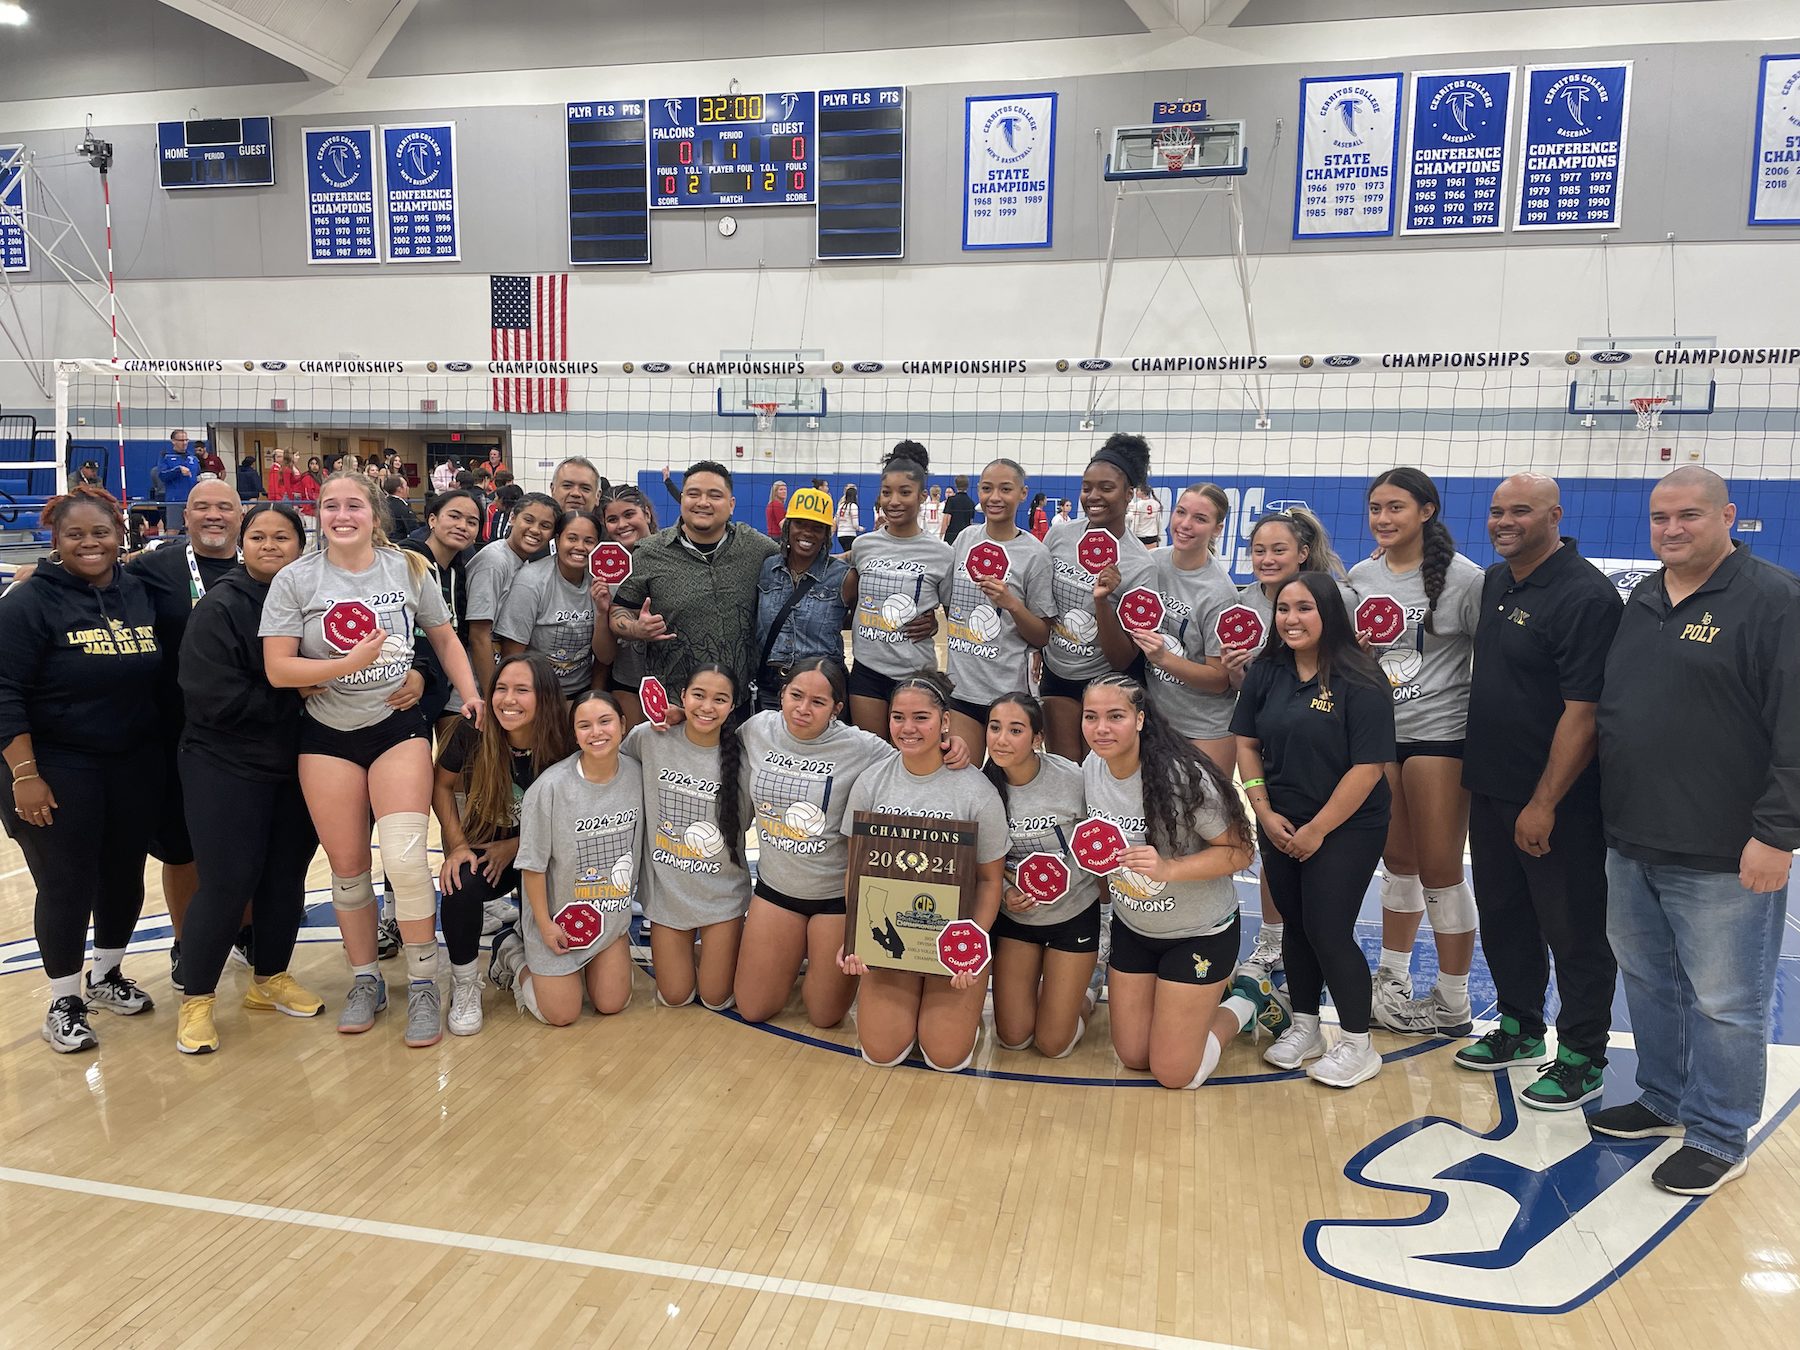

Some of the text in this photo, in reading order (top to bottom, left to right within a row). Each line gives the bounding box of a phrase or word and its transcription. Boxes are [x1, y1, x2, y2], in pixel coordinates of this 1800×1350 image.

[1430, 80, 1493, 111] CERRITOS COLLEGE
[1545, 74, 1609, 104] CERRITOS COLLEGE
[823, 91, 899, 106] PLYR FLS PTS
[1320, 87, 1380, 117] CERRITOS COLLEGE
[569, 104, 640, 118] PLYR FLS PTS
[703, 96, 761, 122] 32:00
[983, 106, 1037, 133] CERRITOS COLLEGE
[653, 127, 695, 139] FALCONS
[720, 131, 743, 139] PERIOD
[772, 122, 803, 135] GUEST
[1557, 127, 1591, 137] BASEBALL
[420, 133, 441, 156] COLLEGE
[1442, 133, 1476, 143] BASEBALL
[165, 144, 266, 159] HOME GUEST
[341, 136, 361, 159] COLLEGE
[680, 142, 692, 164] 0
[732, 143, 737, 158] 1
[792, 137, 804, 160] 0
[1415, 147, 1501, 160] CONFERENCE
[1530, 142, 1617, 155] CONFERENCE
[205, 152, 224, 160] PERIOD
[1324, 154, 1370, 166] STATE
[1528, 155, 1616, 170] CHAMPIONS
[657, 167, 678, 175] FOULS
[685, 166, 702, 175] T.O.L.
[709, 164, 754, 174] PLAYER FOUL
[760, 164, 778, 172] T.O.L.
[786, 162, 807, 171] FOULS
[1306, 166, 1388, 180] CHAMPIONS
[1415, 160, 1500, 175] CHAMPIONS
[1765, 167, 1789, 175] 2006
[795, 172, 804, 190] 0
[988, 169, 1029, 180] STATE
[1530, 172, 1612, 183] 1976 1977 1978
[665, 176, 675, 194] 0
[689, 176, 699, 193] 2
[746, 175, 751, 190] 1
[765, 173, 774, 190] 2
[972, 181, 1045, 194] CHAMPIONS
[1308, 182, 1384, 192] 1966 1970 1973
[1416, 177, 1496, 188] 1959 1962
[390, 189, 451, 200] CONFERENCE
[1529, 185, 1610, 195] 1979 1987
[312, 192, 371, 202] CONFERENCE
[720, 195, 743, 204] MATCH
[786, 193, 807, 201] SCORE
[1307, 194, 1383, 204] 1974 1975 1979
[1588, 198, 1609, 206] 1990
[312, 203, 372, 214] CHAMPIONS
[391, 201, 452, 212] CHAMPIONS
[1306, 209, 1326, 217] 1985
[1334, 208, 1354, 216] 1987
[1443, 202, 1494, 212] 1970 1972
[315, 217, 329, 225] 1965
[356, 216, 369, 224] 1971
[393, 215, 408, 223] 1993
[1414, 215, 1493, 226] 1973 1974 1975
[1557, 210, 1609, 220] 1992 1995
[1328, 355, 1358, 366] Ford
[1382, 352, 1530, 367] CHAMPIONSHIPS
[1597, 351, 1629, 362] Ford
[1655, 349, 1800, 364] CHAMPIONSHIP
[124, 360, 223, 371] CHAMPIONSHIPS
[299, 361, 403, 373] CHAMPIONSHIPS
[489, 362, 599, 374] CHAMPIONSHIPS
[689, 362, 805, 374] CHAMPIONSHIPS
[858, 363, 882, 371] Ford
[902, 360, 1027, 374] CHAMPIONSHIPS
[1085, 360, 1111, 370] Ford
[1131, 356, 1268, 372] CHAMPIONSHIPS
[796, 494, 828, 514] POLY
[1147, 505, 1152, 515] 9
[865, 560, 925, 573] 20242025
[1680, 624, 1720, 643] POLY
[948, 637, 999, 658] HAMPIONS
[1310, 698, 1334, 712] POLY
[765, 751, 835, 775] 2024-2025
[659, 769, 721, 795] 2024-202
[1008, 816, 1057, 831] 4-2025
[870, 825, 959, 843] CHAMPIONS
[652, 849, 721, 874] CHAMPIONS
[868, 850, 956, 875] 20 24
[1024, 872, 1047, 897] CHAMPIONS
[916, 897, 933, 911] CIF
[948, 954, 980, 967] CHAMPIONS
